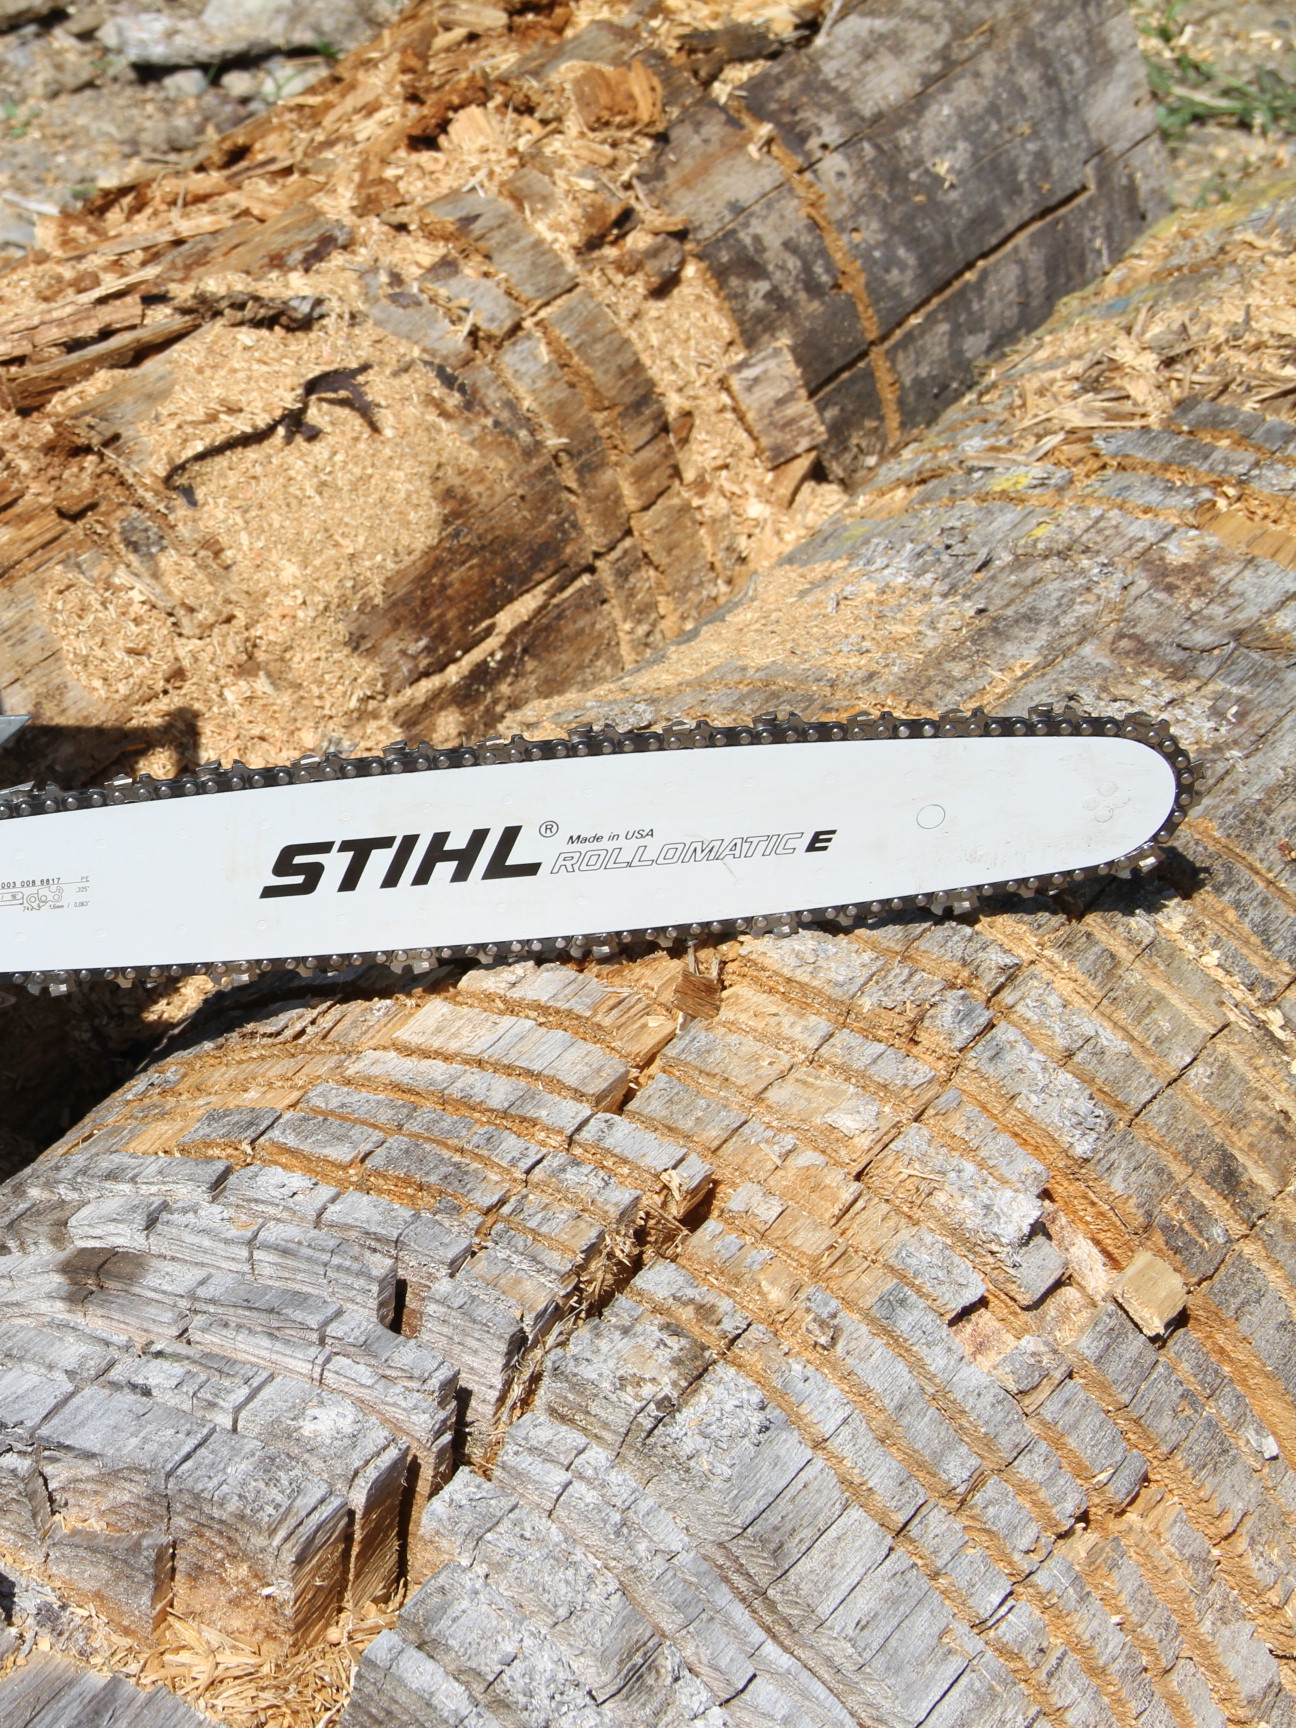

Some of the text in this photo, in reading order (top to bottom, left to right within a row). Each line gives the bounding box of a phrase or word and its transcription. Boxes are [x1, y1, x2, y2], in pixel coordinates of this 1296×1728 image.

[550, 832, 804, 875] ROLLOMATIC
[566, 828, 655, 846] Made in USA
[259, 825, 542, 899] STIHL
